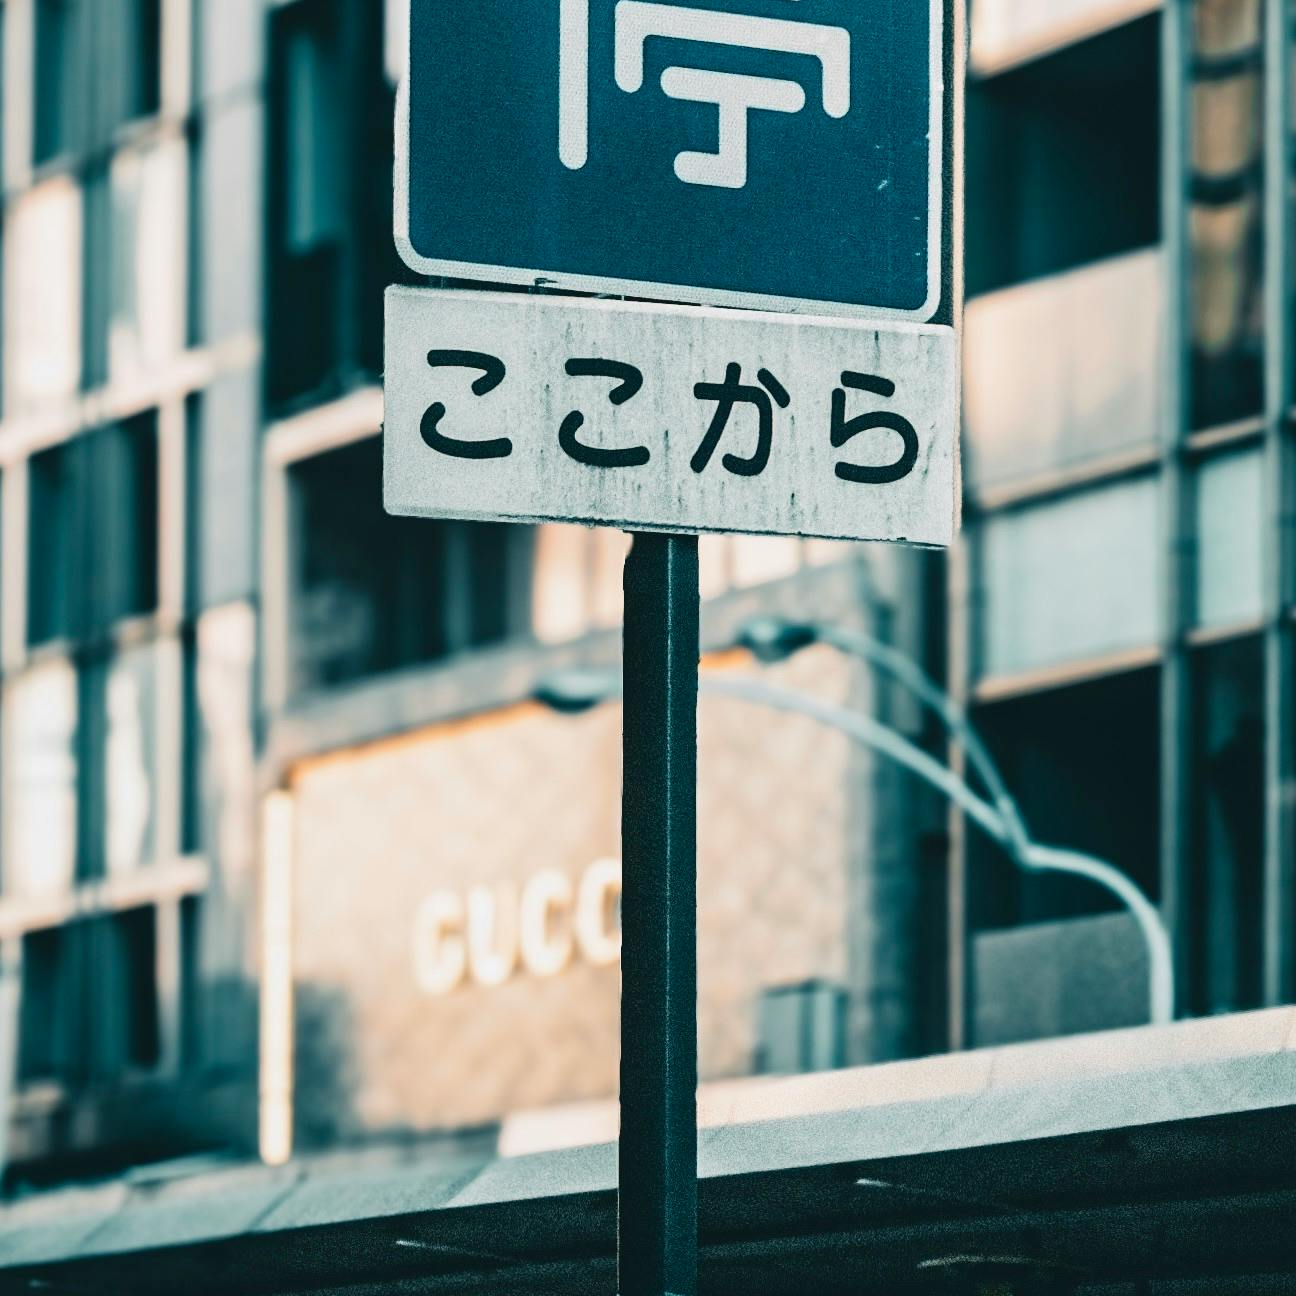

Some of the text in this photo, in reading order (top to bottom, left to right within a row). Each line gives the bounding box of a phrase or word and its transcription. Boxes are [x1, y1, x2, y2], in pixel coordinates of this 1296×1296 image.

[420, 349, 919, 484] ここから
[415, 858, 621, 994] GUCC
